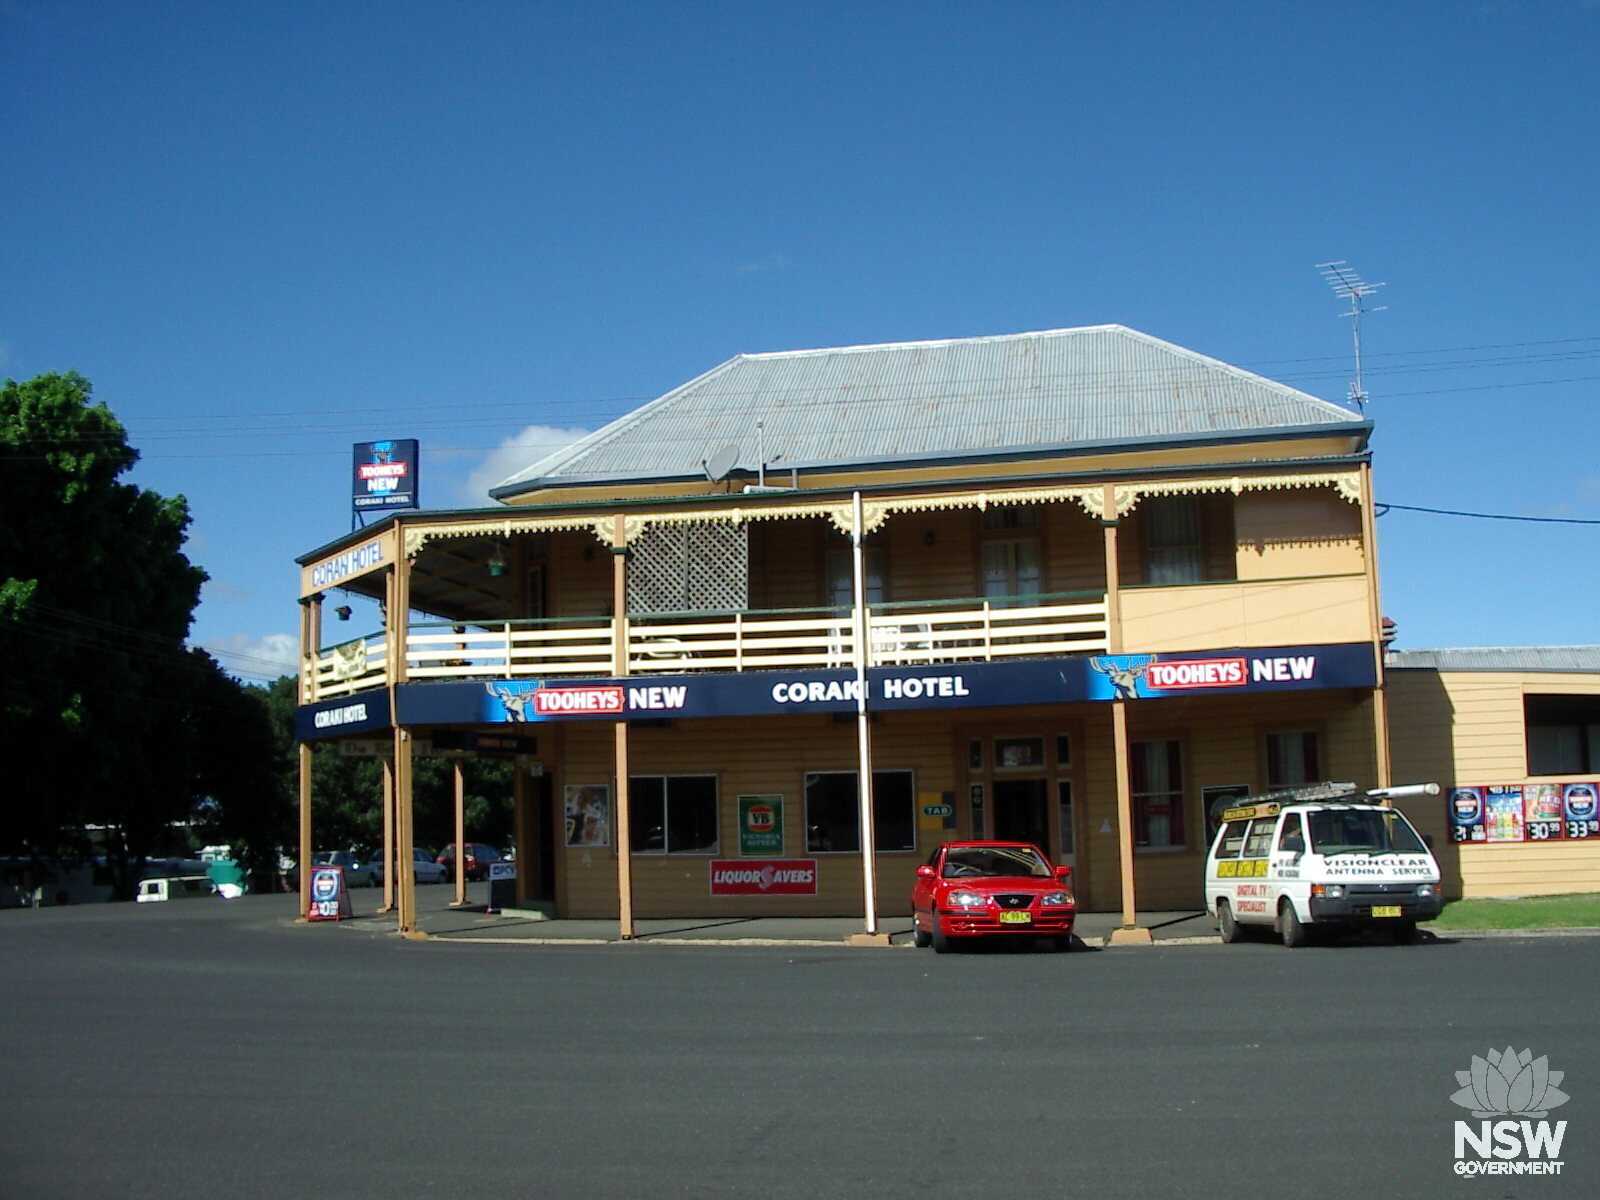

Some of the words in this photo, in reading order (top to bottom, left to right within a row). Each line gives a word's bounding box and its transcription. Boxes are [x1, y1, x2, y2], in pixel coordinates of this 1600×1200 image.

[361, 464, 405, 478] TOOHEYS
[367, 477, 399, 491] NEW
[355, 497, 384, 506] CORAKI
[385, 495, 410, 504] HOTEL
[352, 540, 383, 572] HOTEL
[1150, 662, 1242, 686] TOOHEYS
[1252, 656, 1316, 682] NEW
[772, 680, 870, 703] CORAKI
[884, 676, 970, 699] HOTEL
[538, 691, 618, 710] TOOHEYS
[629, 686, 687, 710] NEW
[314, 707, 344, 729] CORAKI
[344, 703, 368, 724] HOTEL
[926, 805, 949, 815] TAB
[752, 813, 771, 825] VB
[1323, 859, 1428, 867] VISIONCLEAR
[1326, 868, 1385, 876] ANTENNA
[1392, 868, 1432, 876] SERVICE
[1237, 885, 1258, 897] DIGITAL
[1259, 885, 1268, 897] TV
[1237, 901, 1267, 913] SPECIALIST
